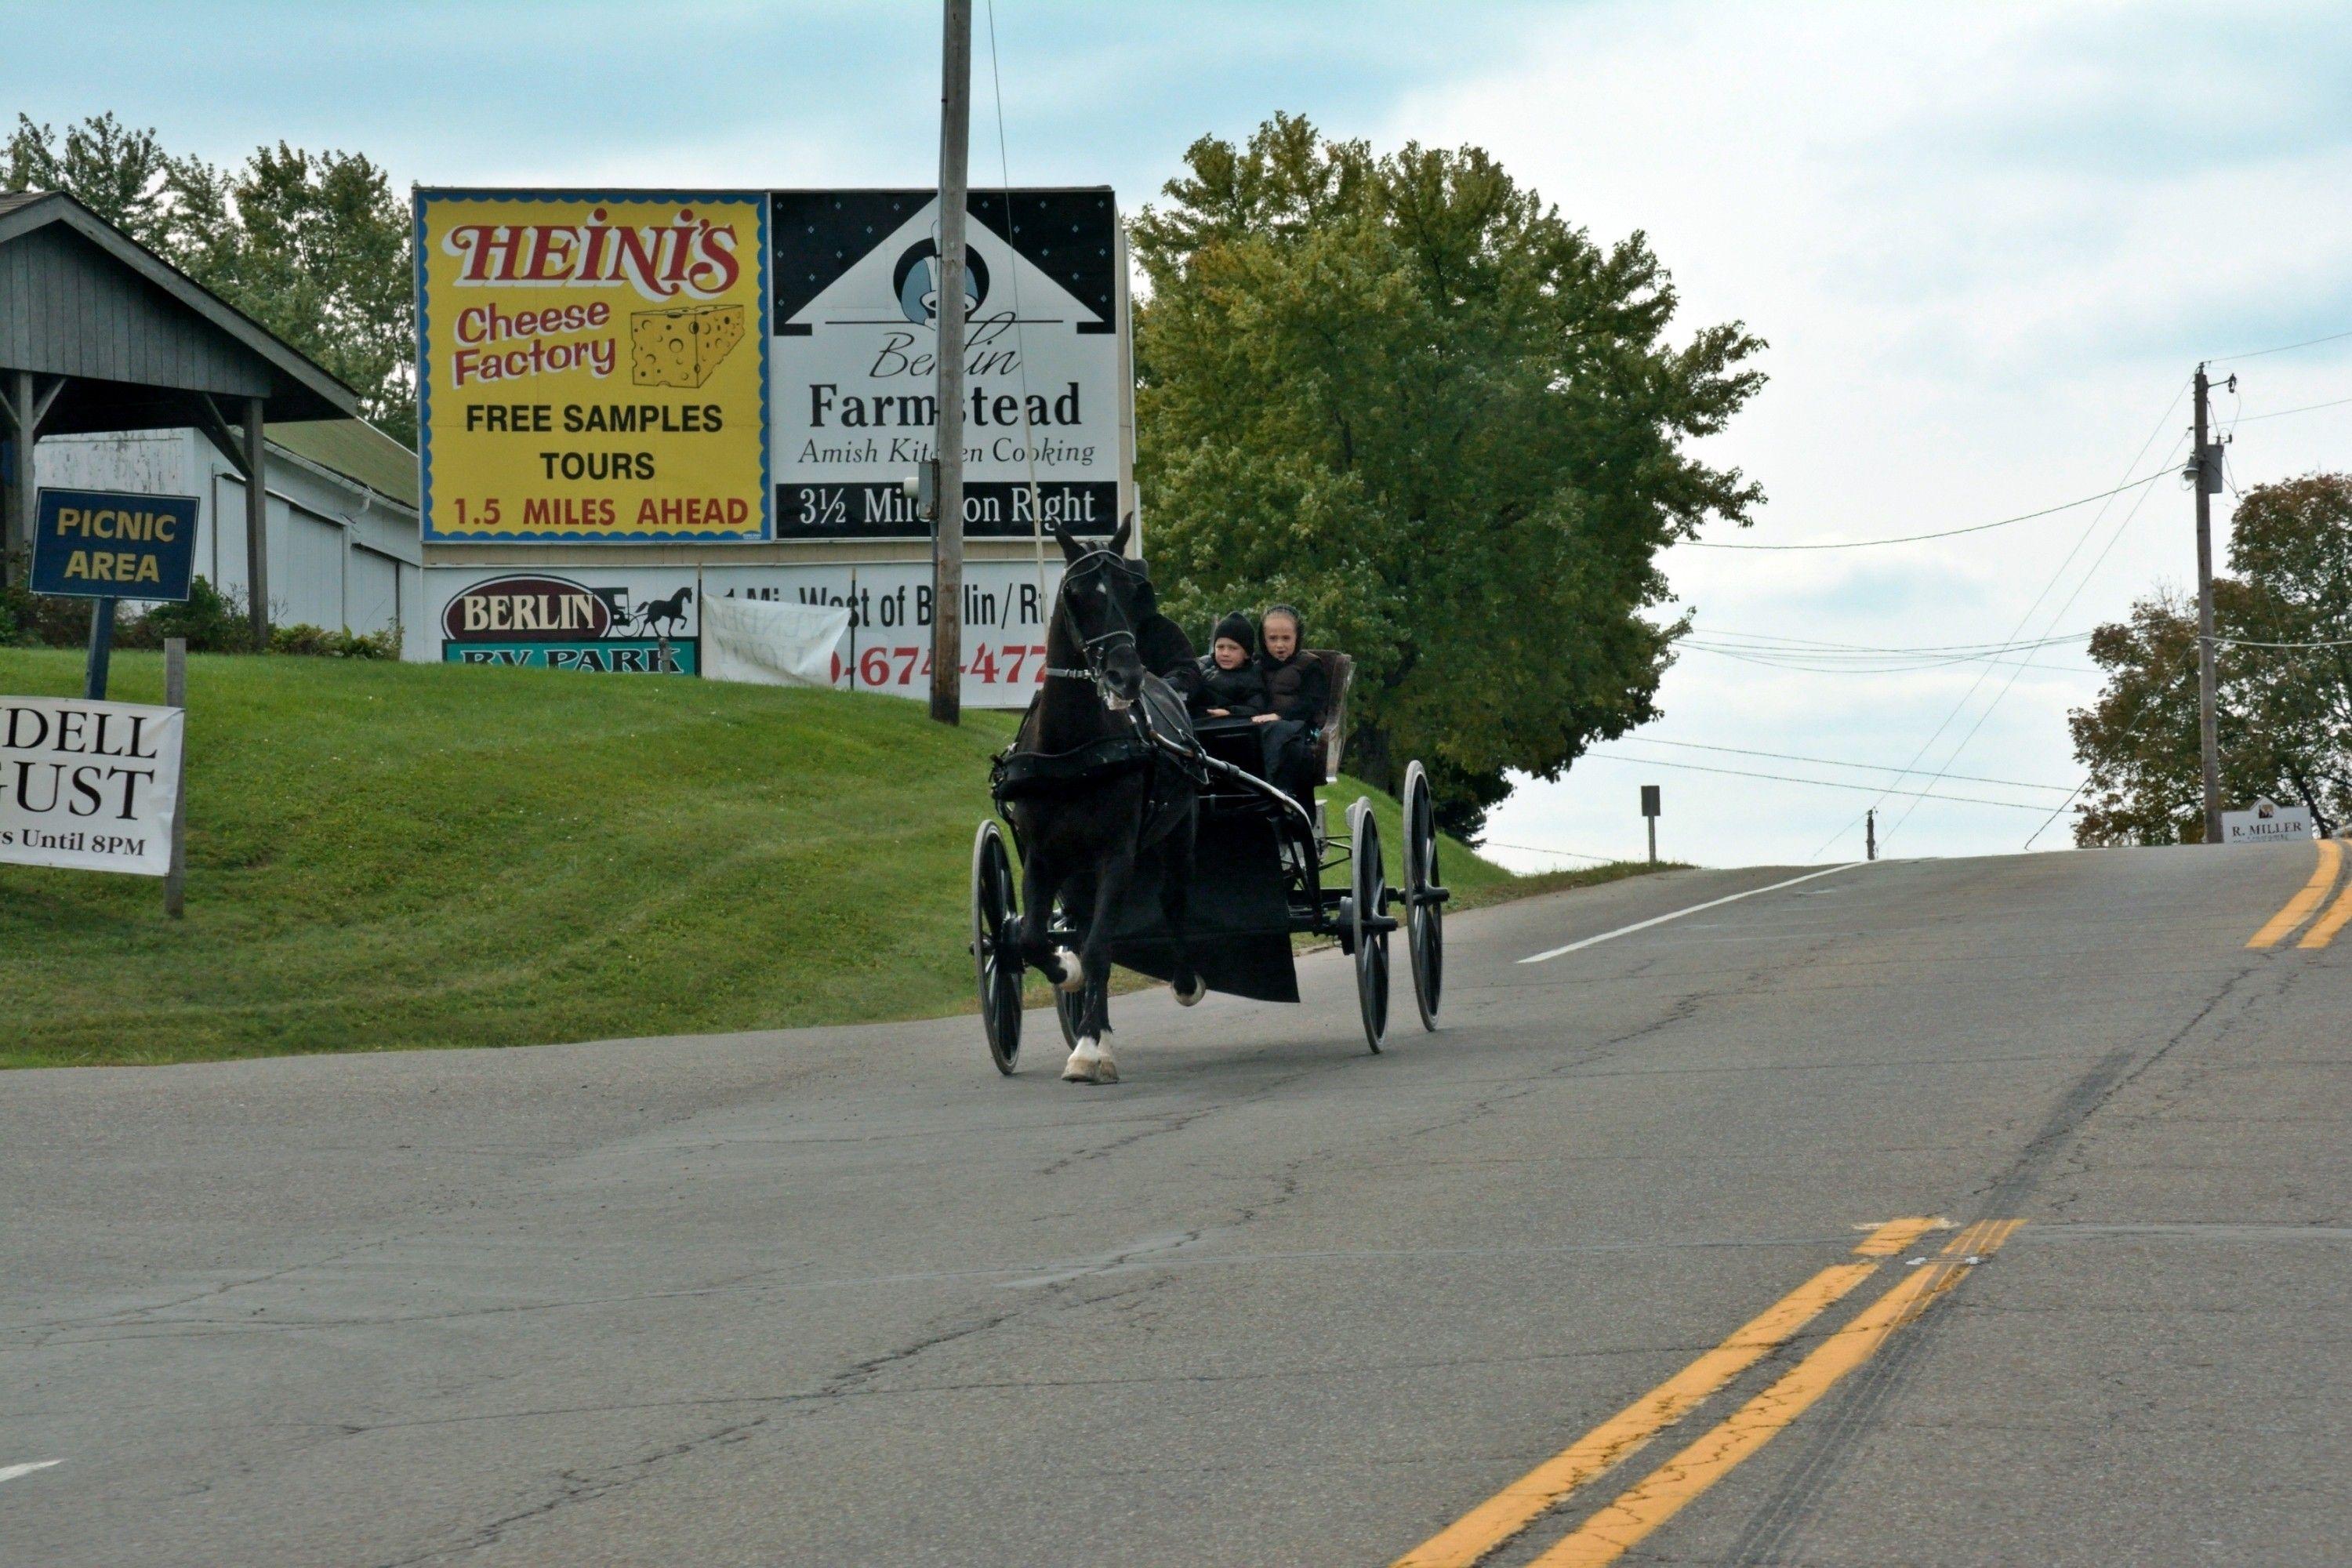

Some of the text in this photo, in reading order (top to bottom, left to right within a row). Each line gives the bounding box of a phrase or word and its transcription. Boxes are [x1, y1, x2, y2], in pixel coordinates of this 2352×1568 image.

[457, 302, 610, 343] Cheese
[454, 337, 616, 387] Factory
[869, 311, 1022, 379] Belin
[466, 404, 723, 433] FREE SAMPLES
[809, 382, 1083, 427] Farmtead
[540, 452, 655, 480] TOURS
[797, 437, 1095, 466] Amish Kiten Cooking
[56, 507, 177, 543] PICNIC
[454, 498, 749, 525] 1.5 MILES AHEAD
[963, 496, 1001, 523] on
[1011, 487, 1096, 531] Right
[64, 550, 160, 583] AREA
[463, 593, 596, 631] BERLIN
[880, 585, 906, 627] of
[916, 584, 996, 626] Blin
[460, 648, 684, 674] RV PARK
[4, 707, 158, 760] DELL
[0, 760, 155, 821] UST
[22, 828, 85, 851] Until
[91, 834, 147, 856] 8PM
[2232, 822, 2302, 837] R. MILLER
